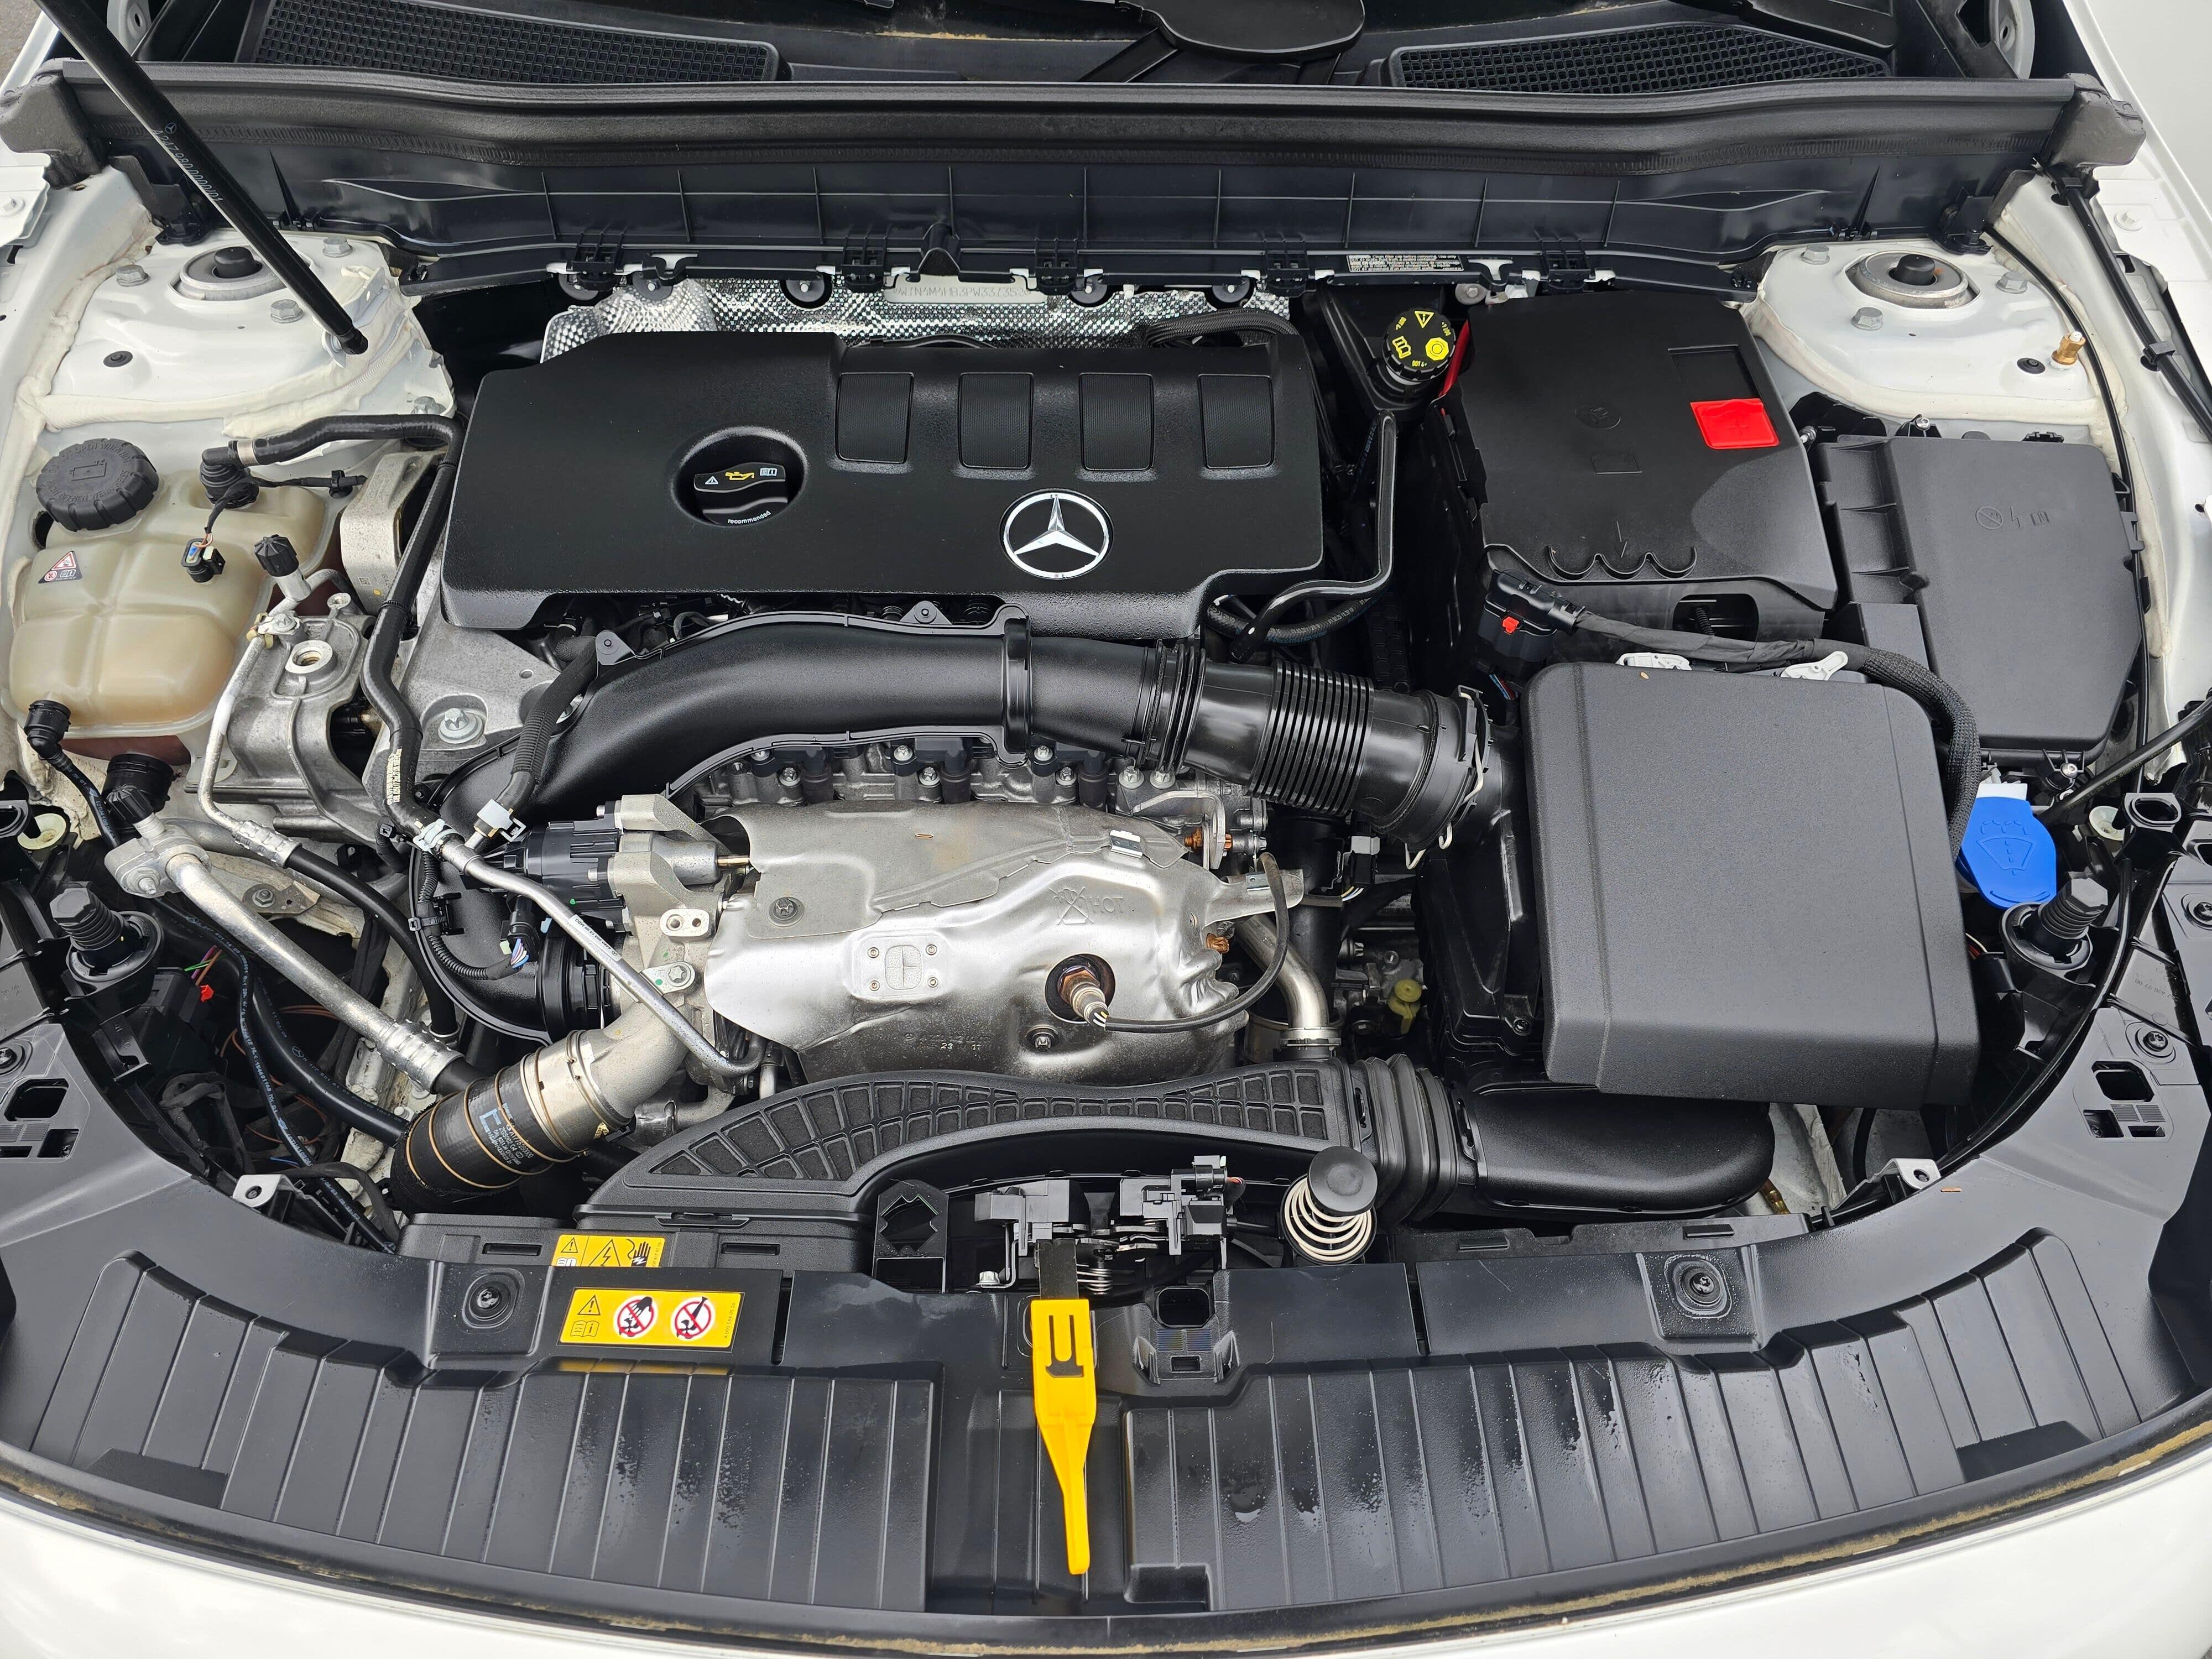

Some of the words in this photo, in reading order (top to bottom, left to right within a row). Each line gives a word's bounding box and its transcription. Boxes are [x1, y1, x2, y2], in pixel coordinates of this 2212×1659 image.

[75, 443, 97, 453] OPEN
[727, 510, 771, 524] recommended
[1089, 896, 1124, 914] HOT
